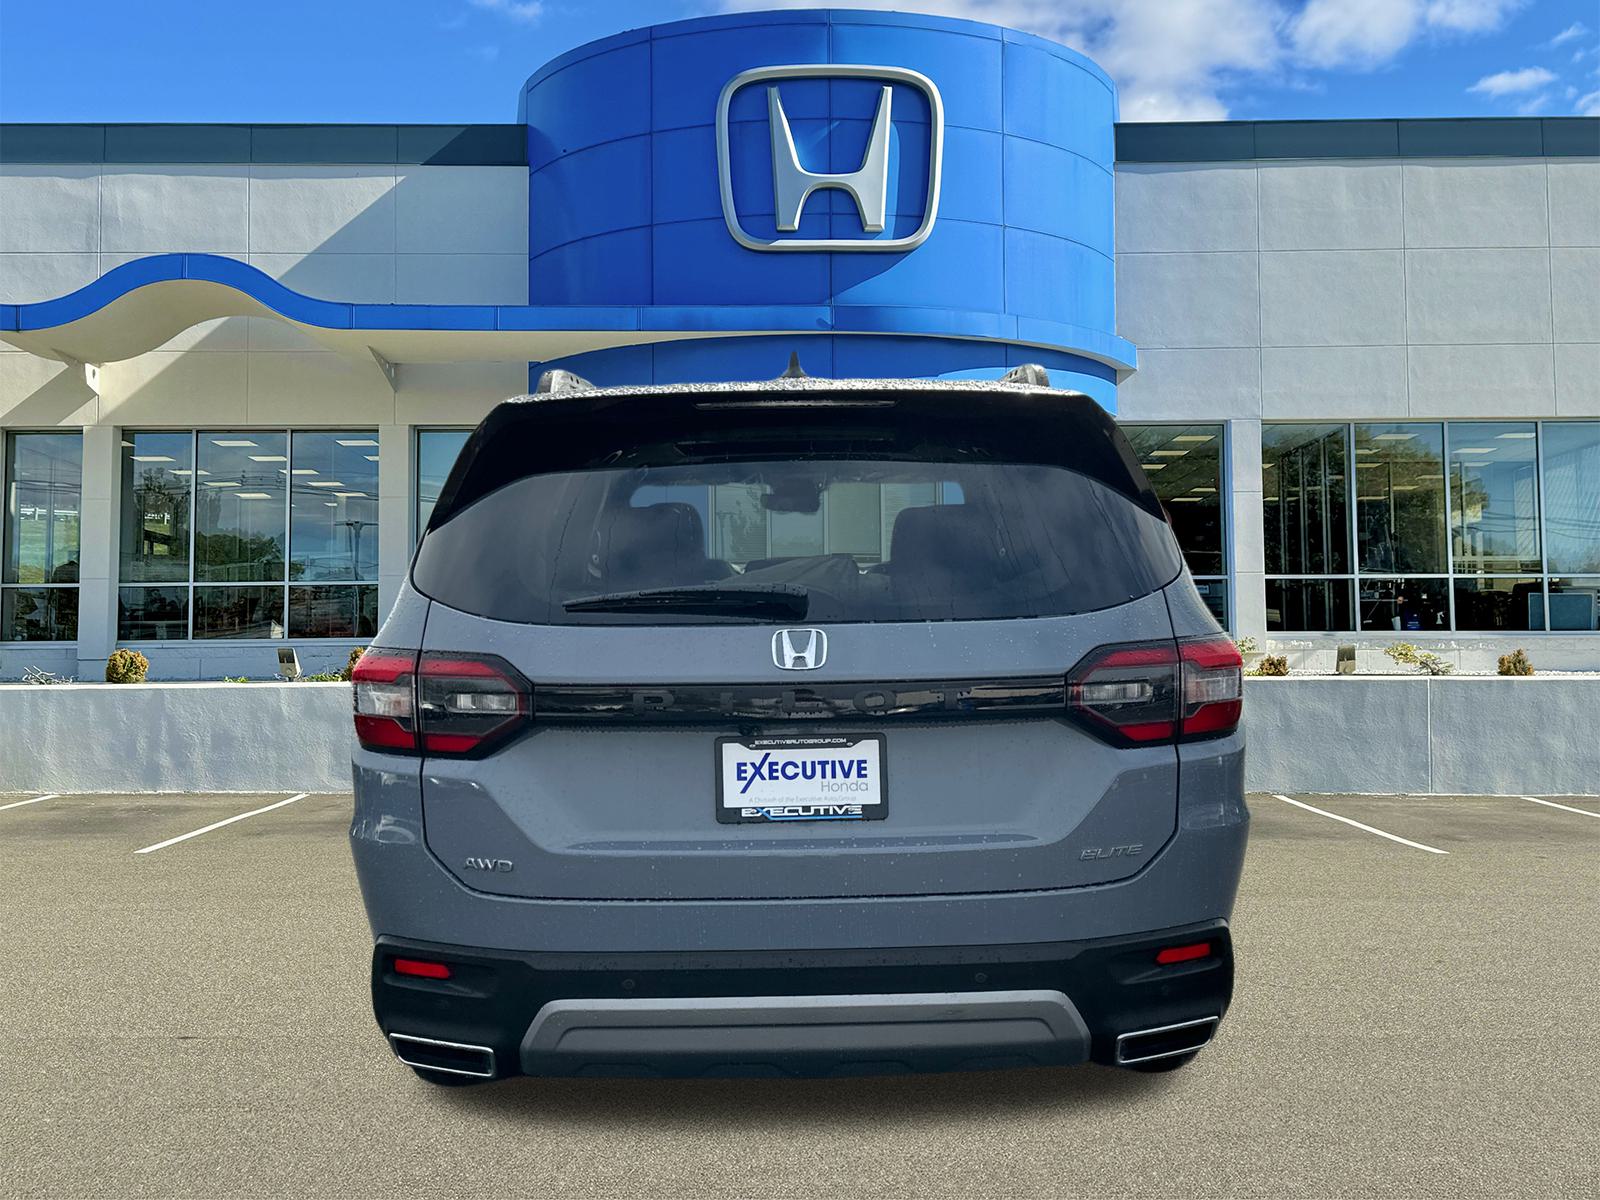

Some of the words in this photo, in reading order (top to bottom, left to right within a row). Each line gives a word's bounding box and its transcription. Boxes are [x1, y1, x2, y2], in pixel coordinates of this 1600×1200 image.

[736, 752, 868, 794] EXECUTIVE
[820, 780, 869, 793] Honda
[741, 805, 863, 818] EXECUTIVE
[1079, 844, 1143, 861] ELITE
[464, 857, 513, 872] AWD
